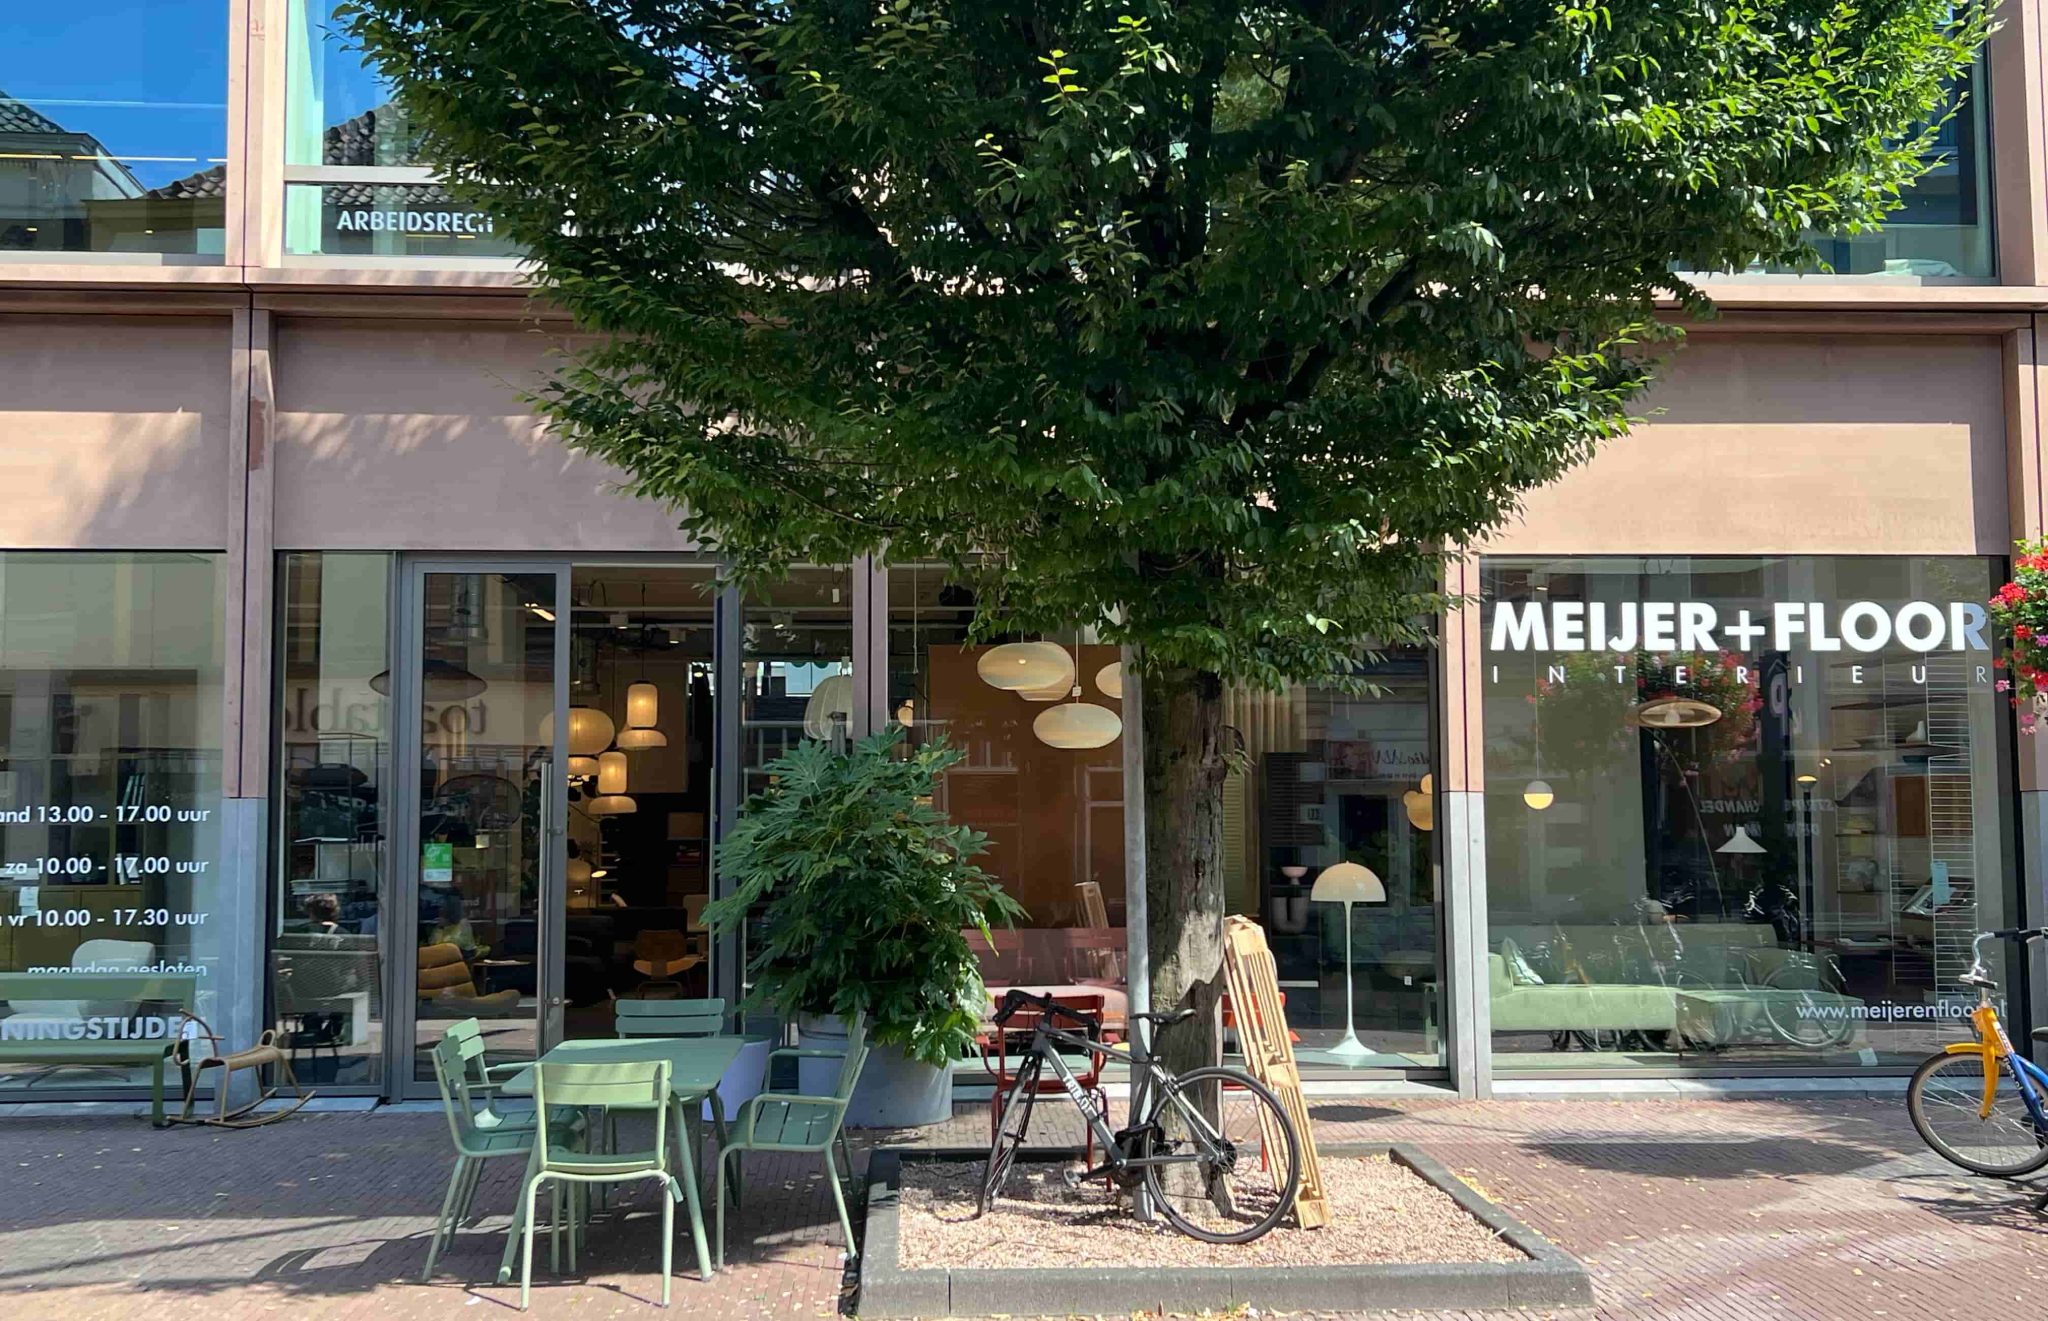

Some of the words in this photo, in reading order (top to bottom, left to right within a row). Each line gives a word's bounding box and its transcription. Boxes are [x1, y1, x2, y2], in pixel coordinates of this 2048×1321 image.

[336, 210, 505, 233] ARBEIDSRECH
[1490, 600, 1990, 652] MEIJER+FLOOR
[1492, 664, 1988, 685] INTERIEUR
[38, 806, 94, 823] 13.00
[115, 806, 171, 823] 17.00
[177, 808, 210, 823] uur
[5, 862, 28, 875] za
[36, 857, 92, 875] 10.00
[114, 857, 170, 874] 17.00
[176, 859, 209, 873] uur
[8, 915, 27, 927] vr
[35, 909, 91, 926] 10.00
[113, 909, 169, 926] 17.30
[174, 912, 209, 925] uur
[1796, 999, 2007, 1023] www.meijerenfloonl
